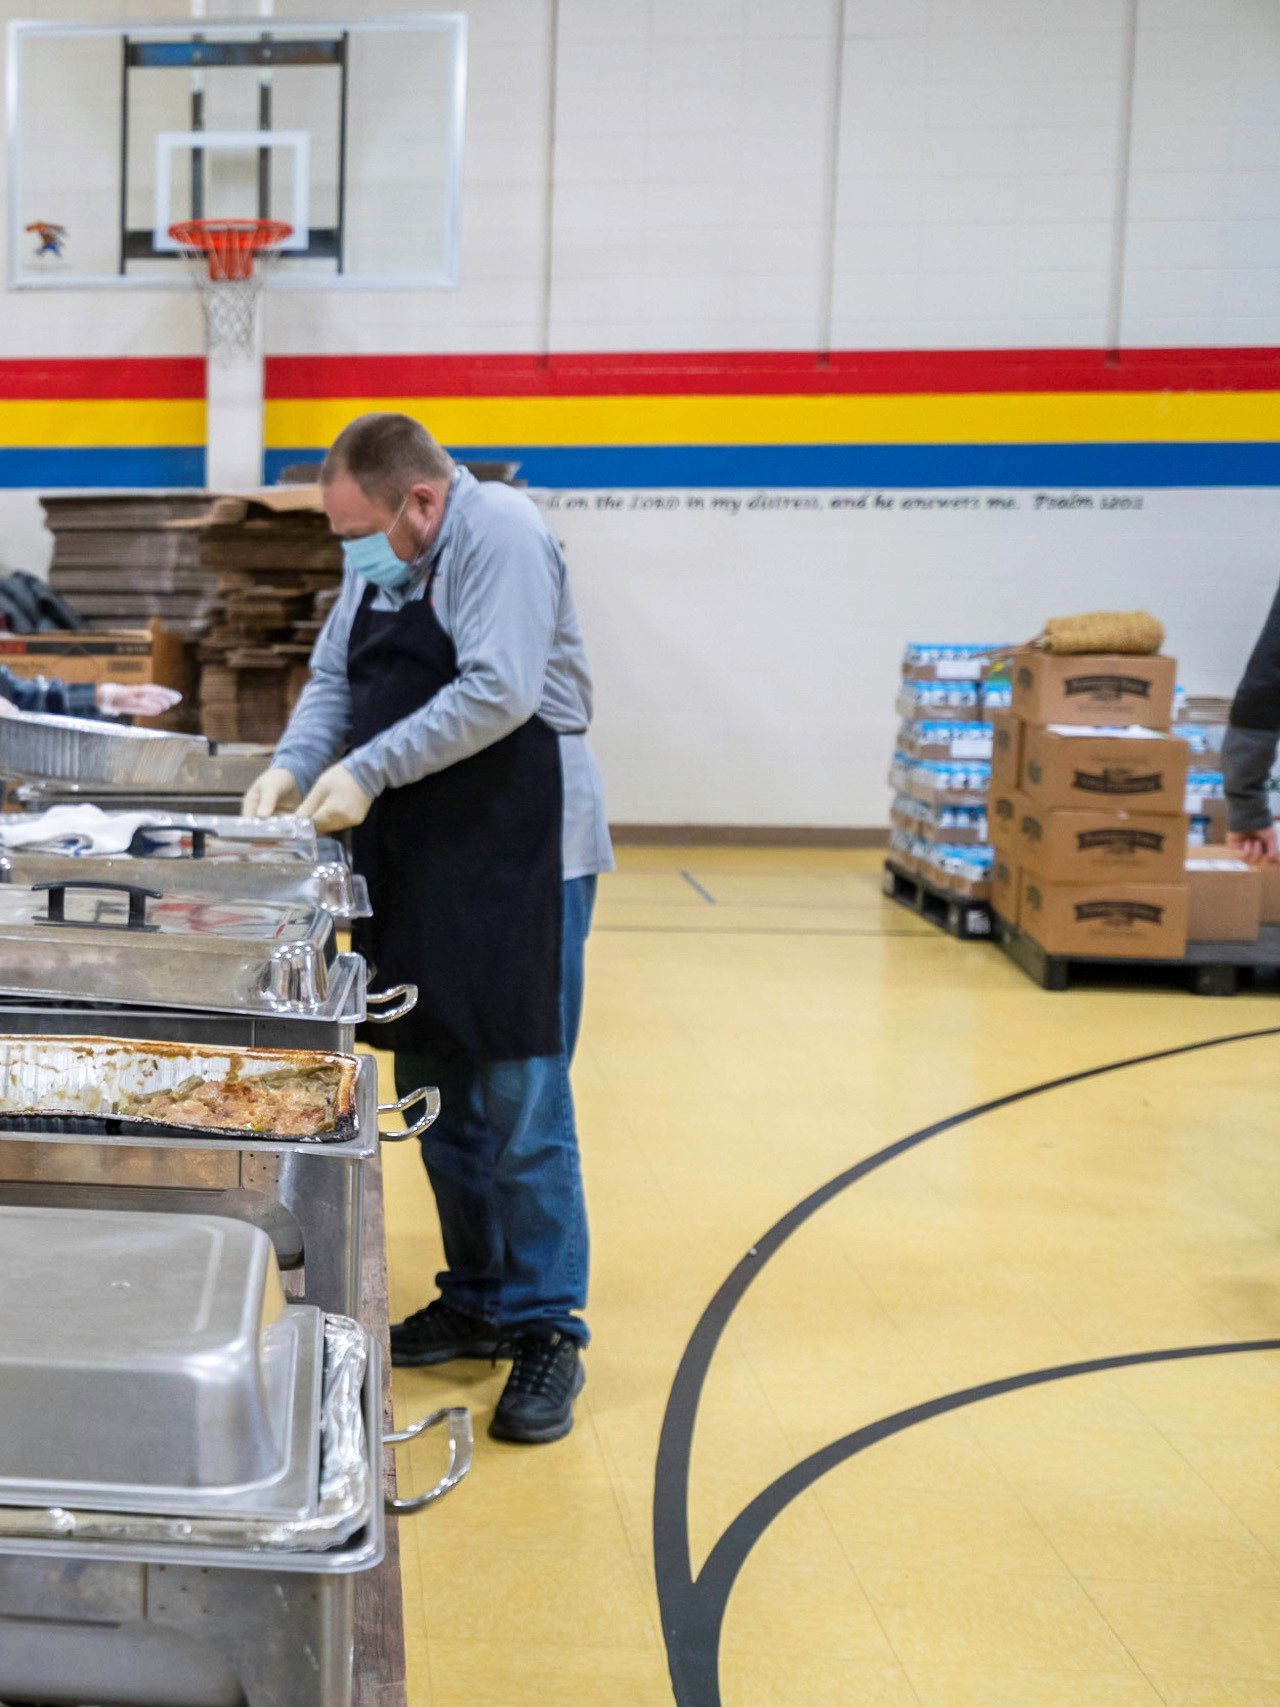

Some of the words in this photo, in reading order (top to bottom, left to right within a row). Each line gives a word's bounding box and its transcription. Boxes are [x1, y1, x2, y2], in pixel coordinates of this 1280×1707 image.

[566, 499, 589, 510] on
[595, 496, 623, 510] the
[686, 497, 707, 510] in
[710, 497, 742, 517] my
[831, 491, 871, 509] and
[874, 494, 894, 509] he
[900, 497, 980, 510] answers
[1033, 491, 1095, 510] Psalm
